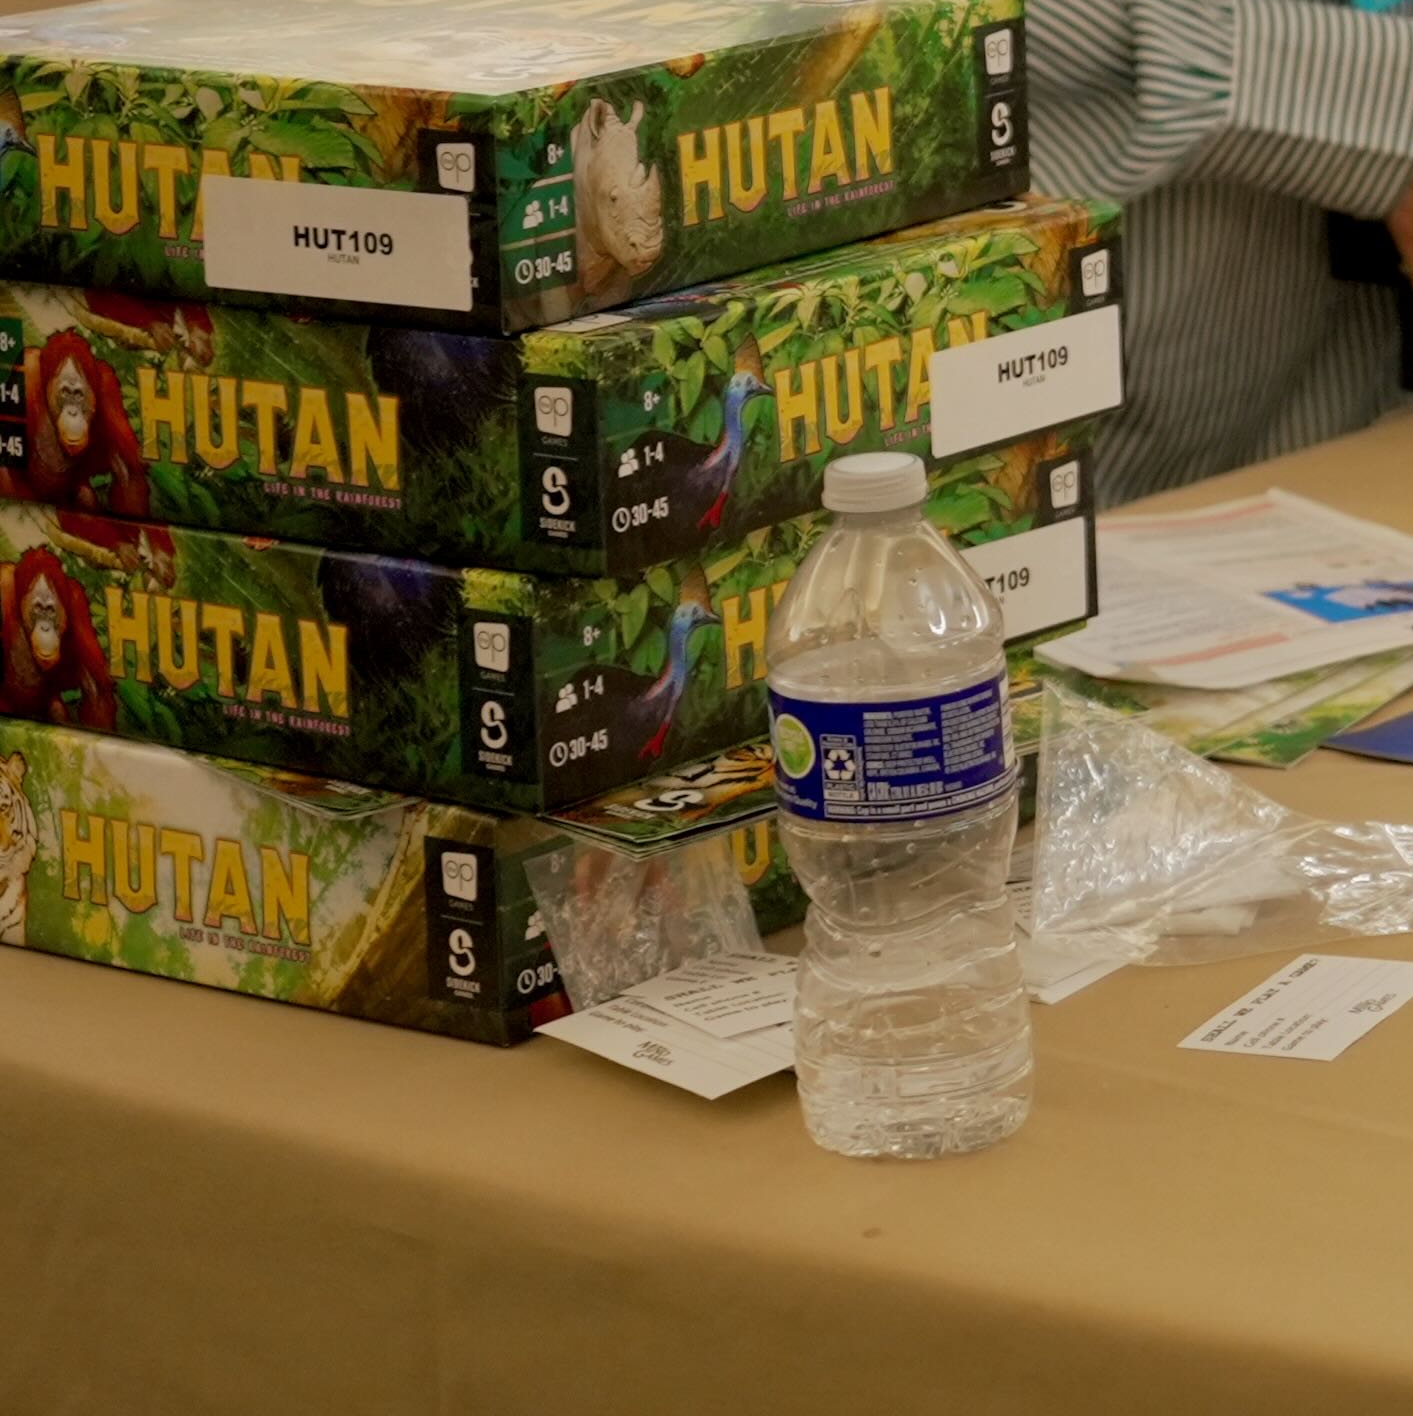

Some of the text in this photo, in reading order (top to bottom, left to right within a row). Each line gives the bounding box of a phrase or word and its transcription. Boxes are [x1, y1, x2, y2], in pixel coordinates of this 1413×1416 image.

[548, 143, 565, 165] 8+
[676, 86, 894, 227] HUTAN
[37, 134, 302, 243] HUT
[549, 195, 569, 219] 1-4
[293, 225, 395, 256] HUT109
[327, 252, 361, 265] HUTAN
[535, 250, 572, 279] 30-45
[998, 345, 1069, 384] HUT109
[644, 391, 661, 412] 8+
[137, 365, 401, 492] HUTAN
[644, 441, 665, 466] 1-4
[632, 496, 670, 527] 30-45
[583, 625, 600, 647] 8+
[105, 585, 349, 719] HUTAN
[583, 675, 604, 701] 1-4
[569, 728, 609, 761] 30-45
[60, 807, 312, 947] HUTAN
